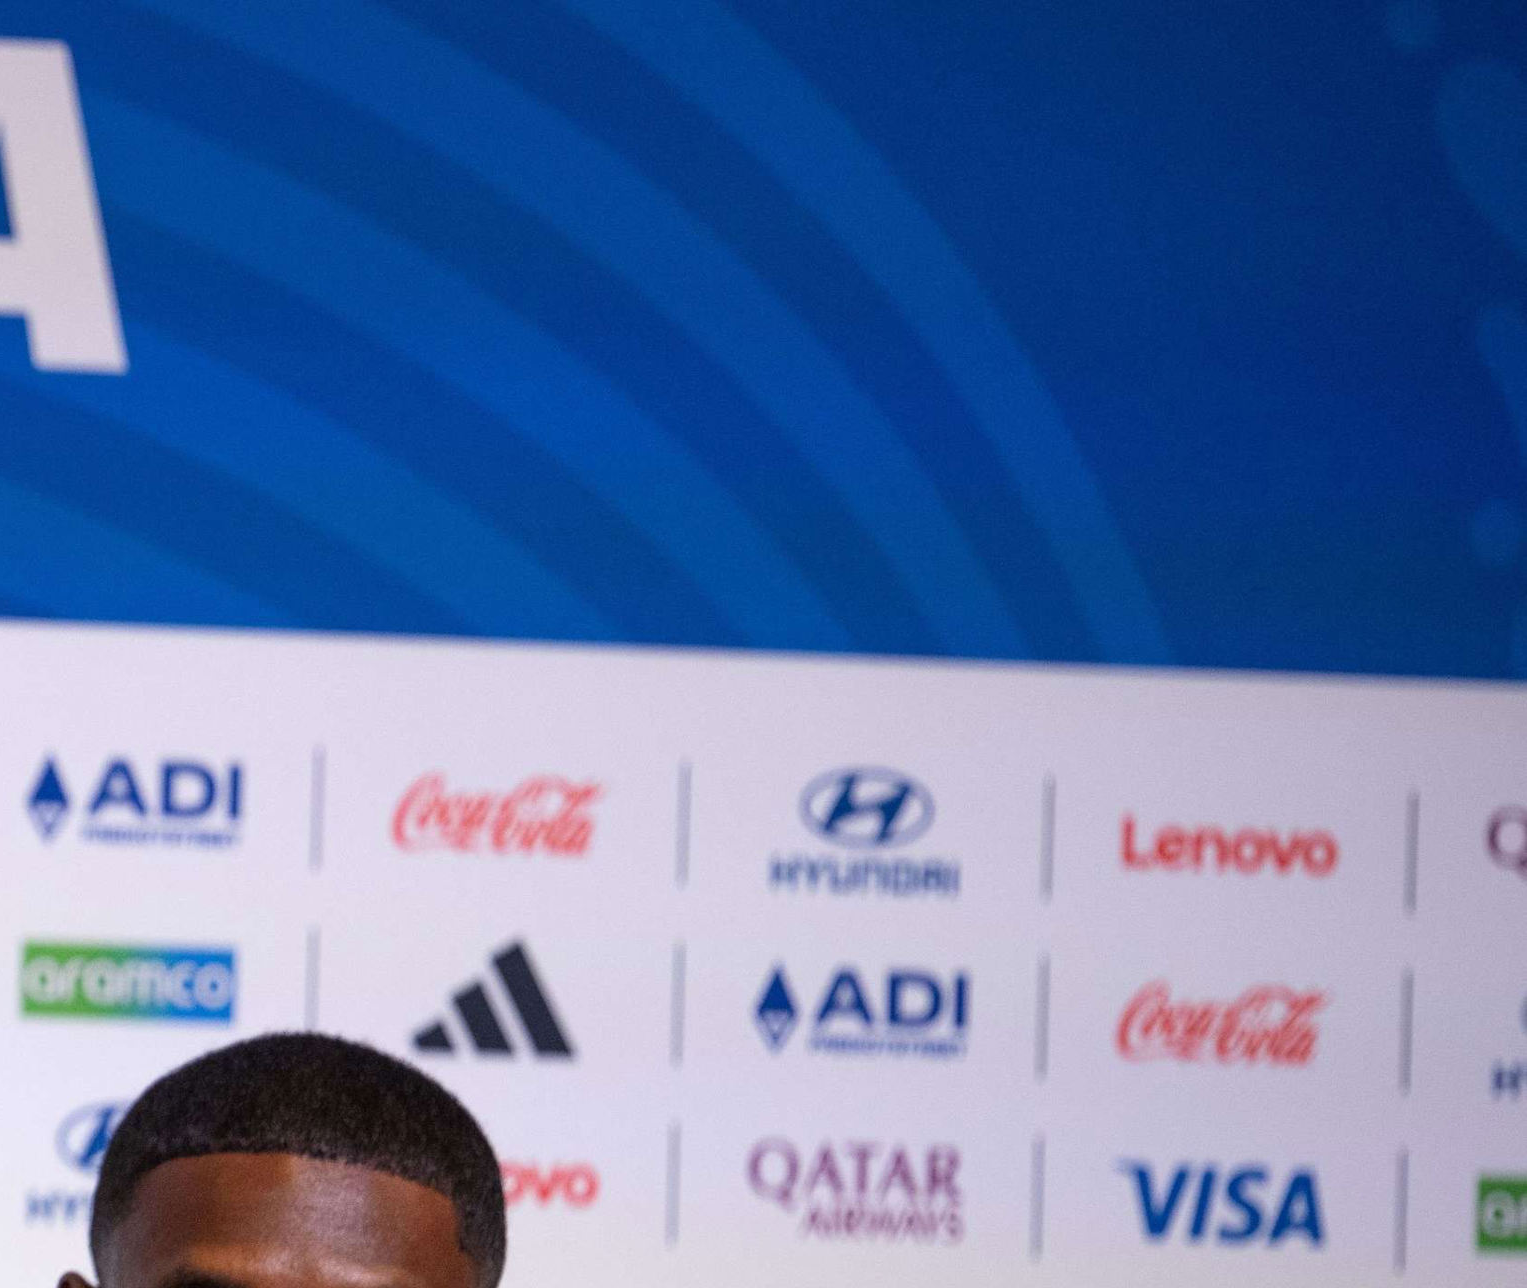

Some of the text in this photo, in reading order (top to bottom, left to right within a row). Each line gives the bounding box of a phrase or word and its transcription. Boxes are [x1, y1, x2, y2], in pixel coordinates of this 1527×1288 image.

[87, 758, 243, 822] ADI
[768, 856, 961, 898] HYUNDAI
[1120, 816, 1341, 878] Lenovo
[23, 951, 231, 1010] aramco
[815, 969, 969, 1038] ADI
[747, 1143, 961, 1210] QATAR
[1121, 1163, 1325, 1247] VISA
